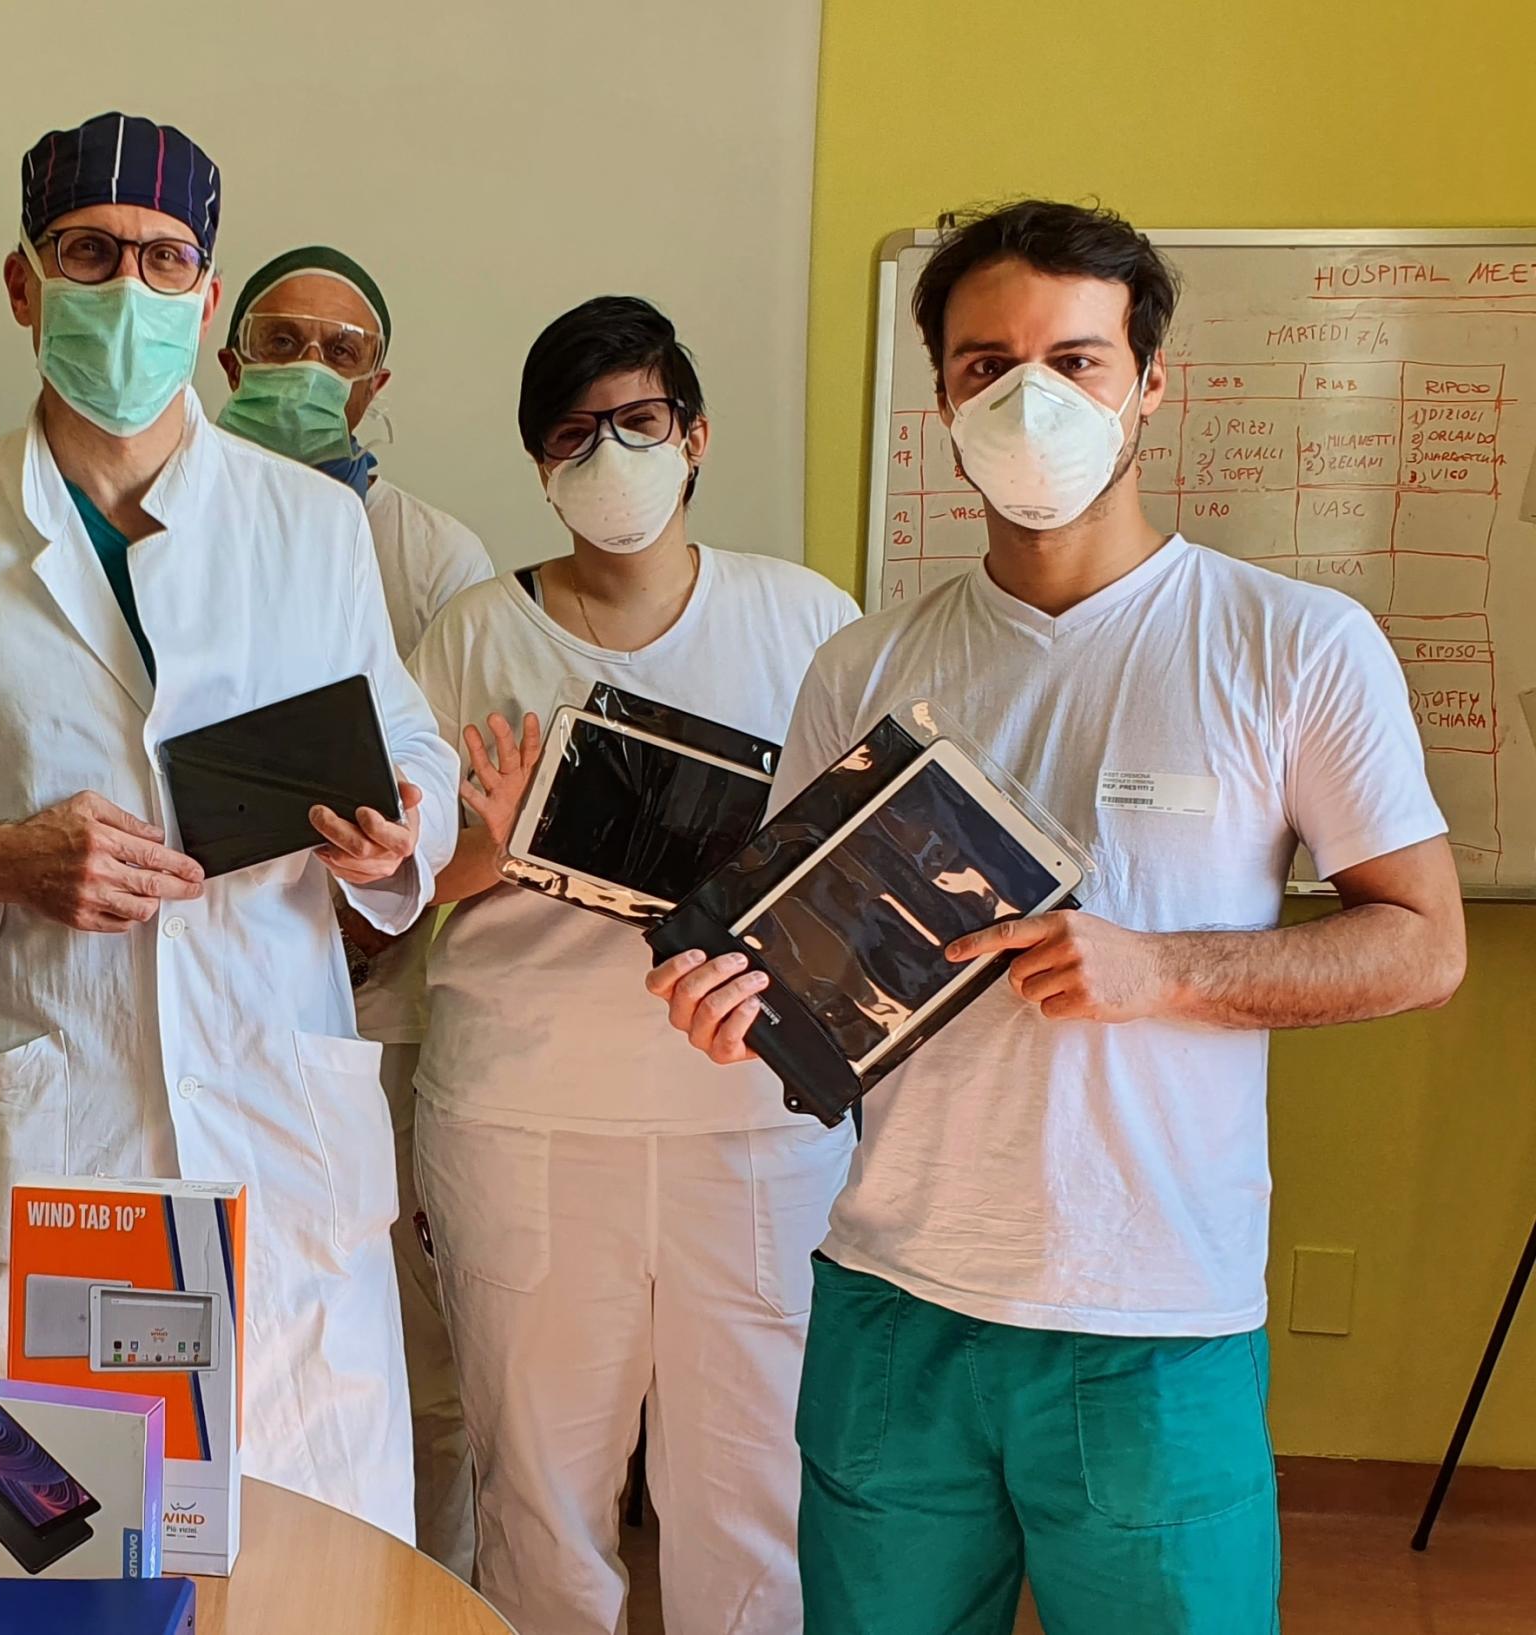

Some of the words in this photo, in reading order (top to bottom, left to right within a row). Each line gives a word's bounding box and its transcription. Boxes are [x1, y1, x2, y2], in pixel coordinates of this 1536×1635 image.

[1314, 264, 1451, 291] HOSPITAL
[1266, 324, 1348, 346] MARTEDI
[1425, 380, 1491, 395] RIPOSO
[899, 426, 909, 441] 8
[1428, 430, 1496, 444] ORLANDO
[893, 450, 913, 467] 17
[1224, 448, 1285, 462] CAVALLI
[1220, 466, 1266, 485] TOFFY
[893, 511, 910, 523] 12
[1195, 502, 1230, 517] URO
[1312, 500, 1365, 518] VASC
[892, 530, 913, 545] 20
[1416, 643, 1475, 658] RIPOSO
[1420, 690, 1480, 715] TOFFY
[1427, 711, 1486, 728] CHIARA
[27, 1200, 75, 1228] WIND
[79, 1203, 111, 1230] TAB
[128, 1533, 138, 1578] enovo
